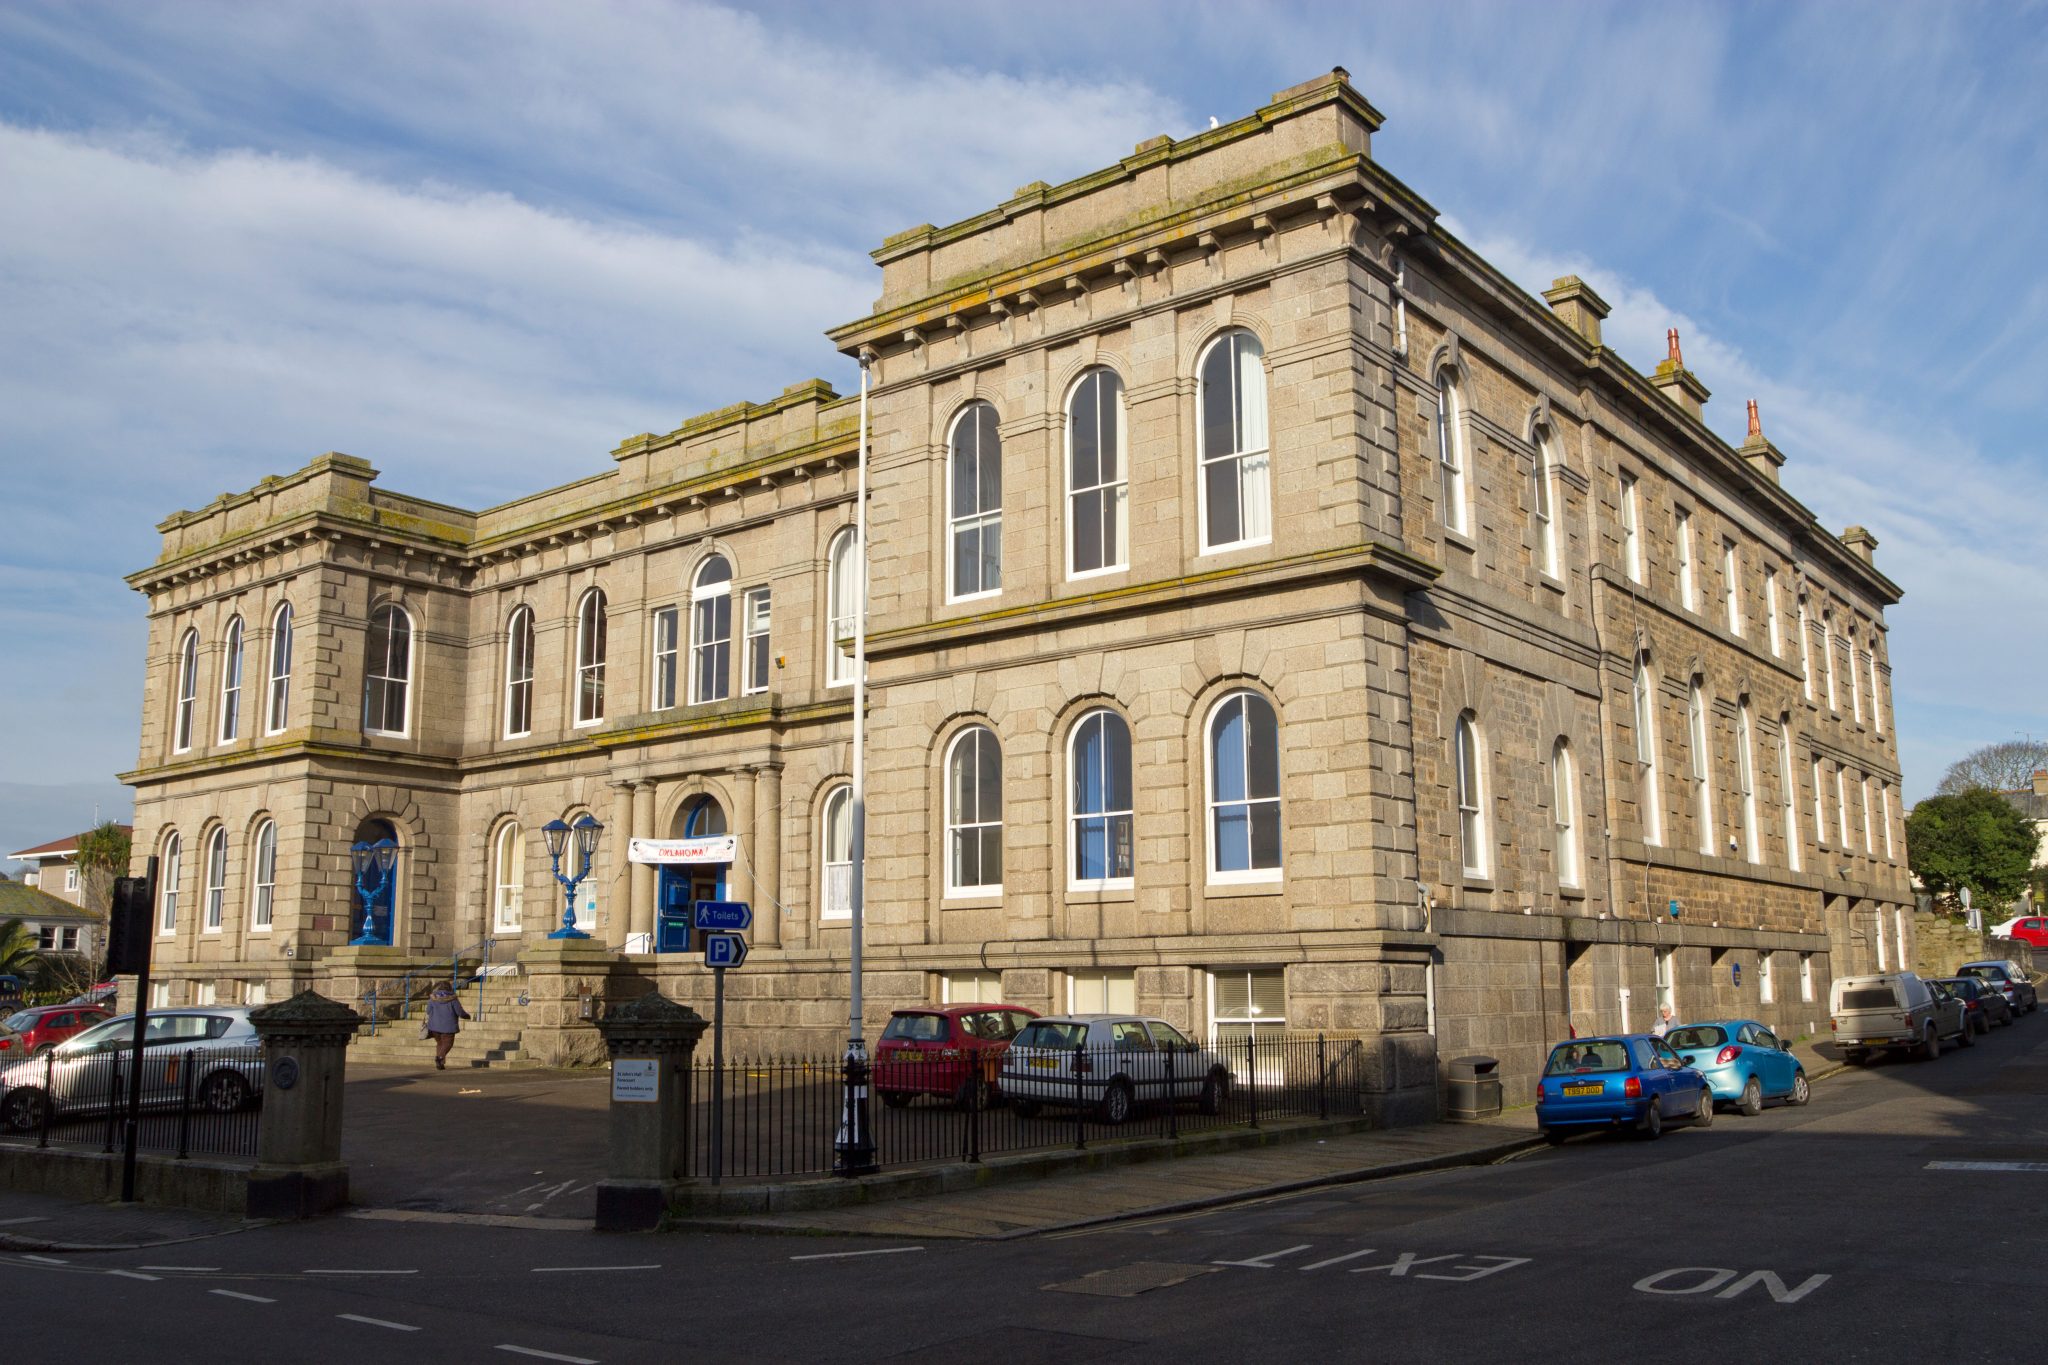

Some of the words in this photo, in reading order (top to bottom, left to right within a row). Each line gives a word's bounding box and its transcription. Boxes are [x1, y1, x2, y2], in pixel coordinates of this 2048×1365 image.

[712, 910, 739, 920] Toilets
[714, 941, 727, 960] P
[1210, 1244, 1533, 1281] EXIT
[1632, 1267, 1832, 1303] NO
